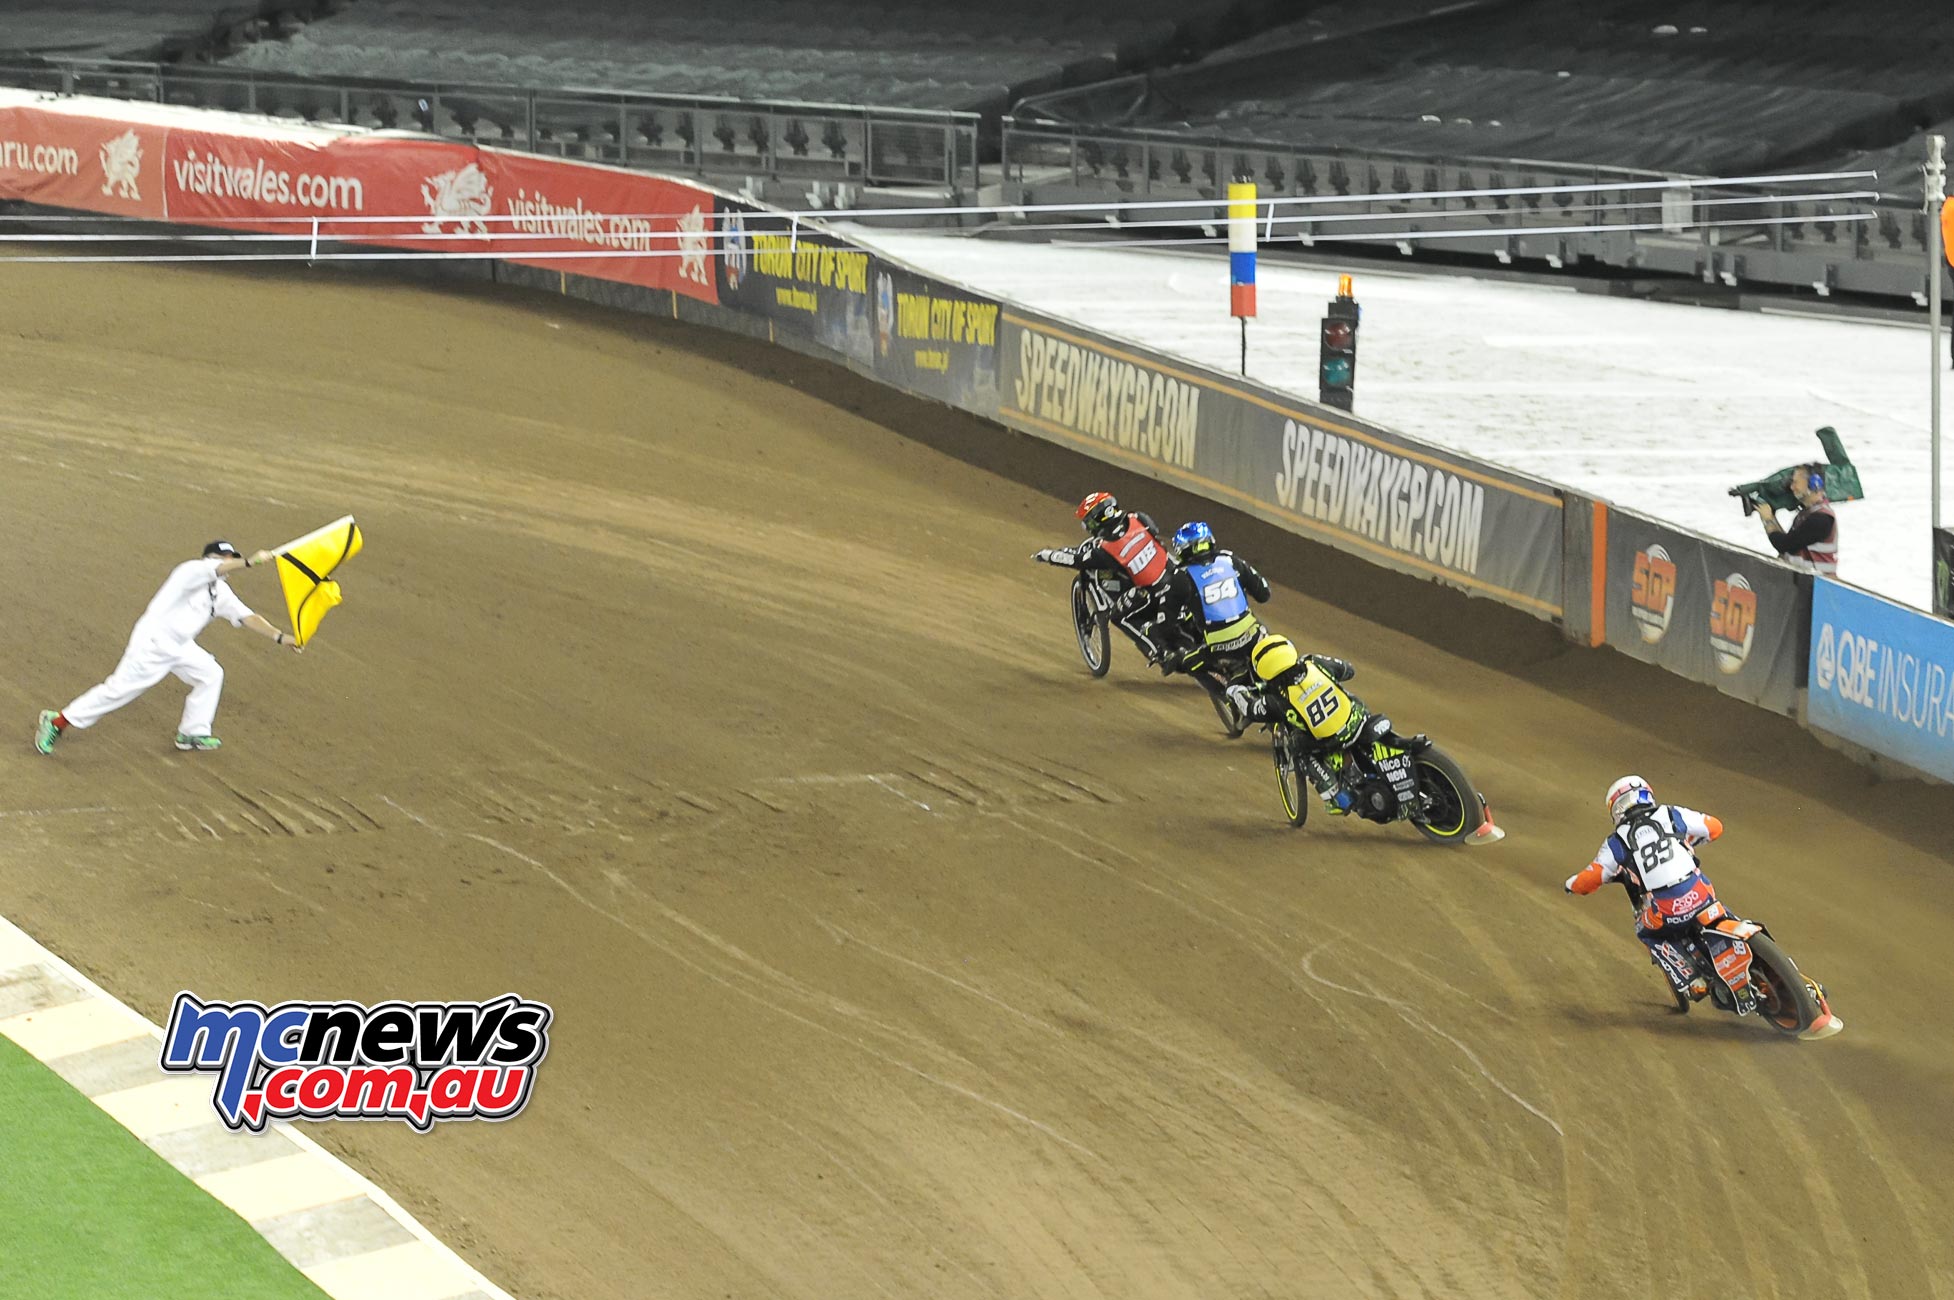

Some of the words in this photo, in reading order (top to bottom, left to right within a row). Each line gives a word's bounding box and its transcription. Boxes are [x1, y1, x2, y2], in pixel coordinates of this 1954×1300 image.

[0, 140, 79, 176] ru.com
[173, 150, 363, 210] visitwales.com
[507, 188, 651, 251] visitwales.com
[1015, 328, 1200, 470] SPEEDWAYGP.COM
[1276, 418, 1485, 575] SPEEDWAYGP.COM
[1127, 540, 1157, 575] 108
[1204, 577, 1238, 605] 54
[1837, 629, 1878, 709] QBE
[1306, 687, 1339, 728] 85
[1640, 839, 1675, 874] 89
